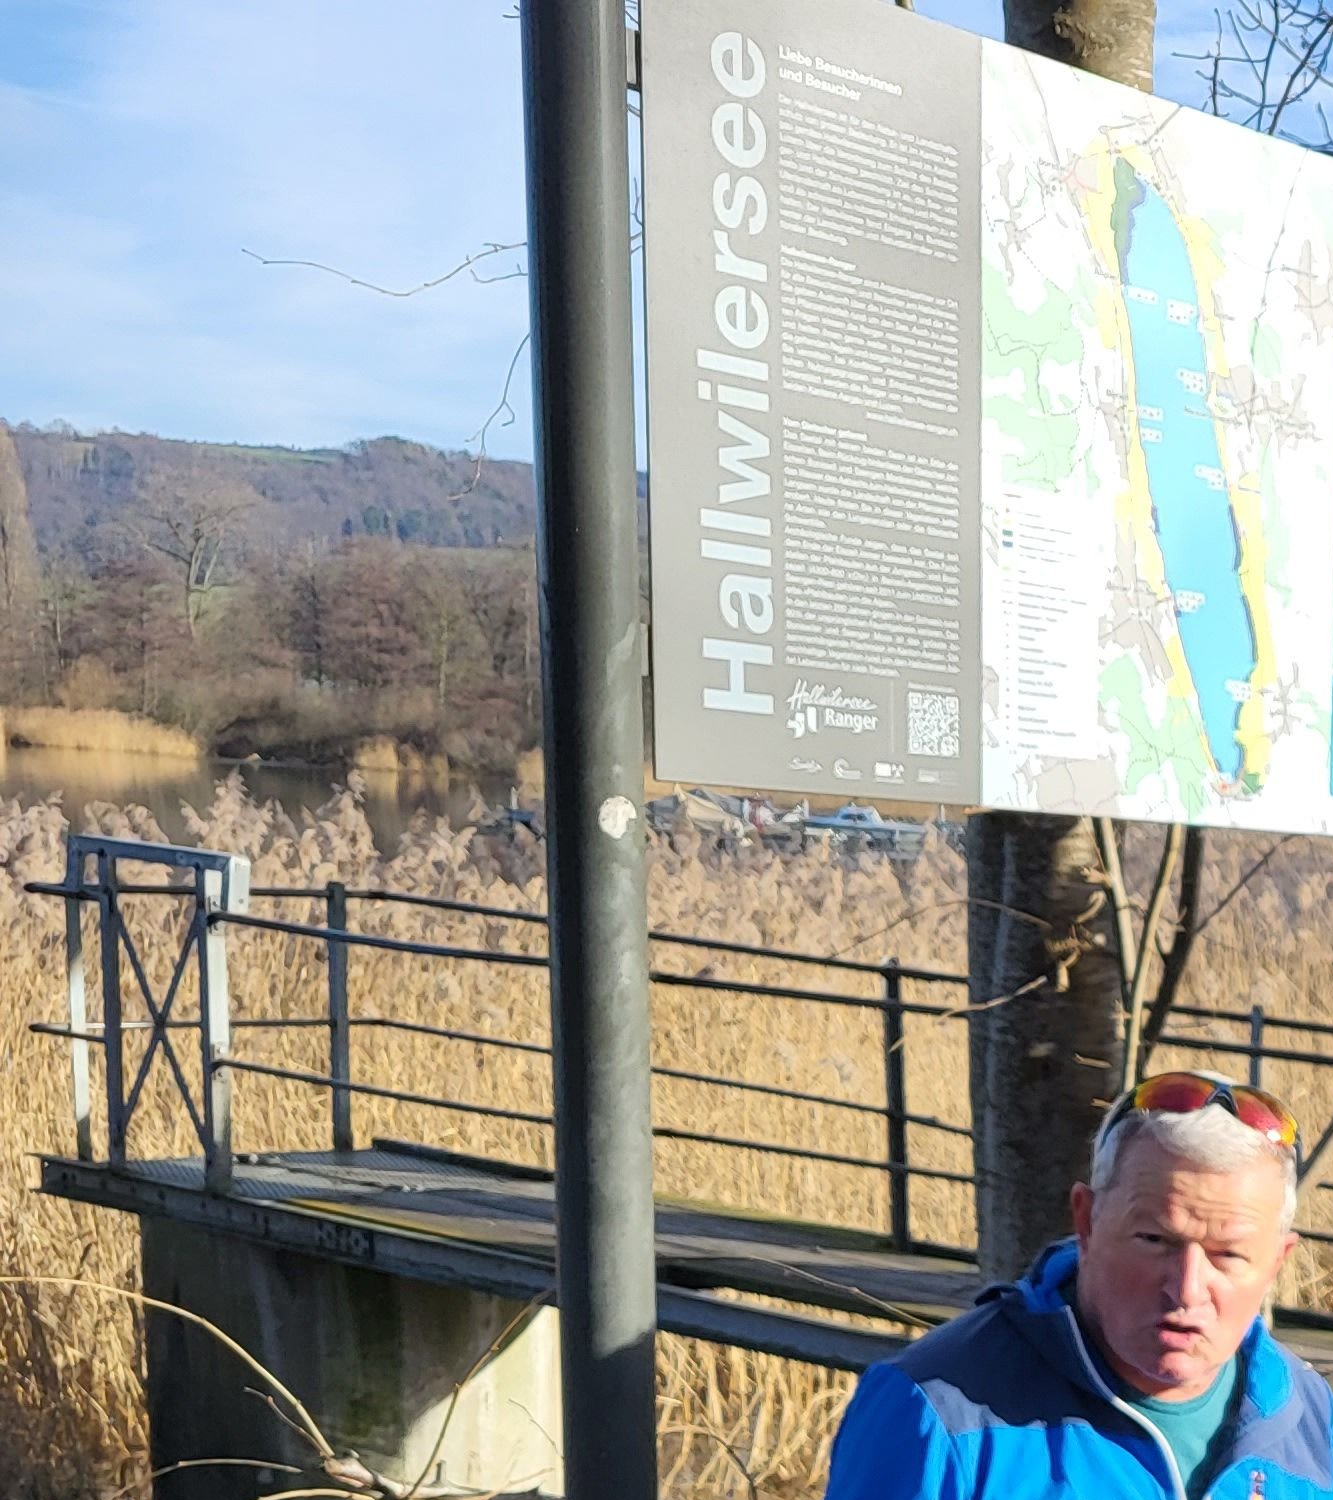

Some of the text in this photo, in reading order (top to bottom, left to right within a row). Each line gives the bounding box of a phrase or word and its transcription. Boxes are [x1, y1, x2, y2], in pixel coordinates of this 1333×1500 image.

[778, 45, 903, 97] Liebe Besucherinnen
[779, 66, 862, 101] und Besucher
[696, 31, 775, 715] Hallwilersee
[824, 707, 879, 734] Ranger
